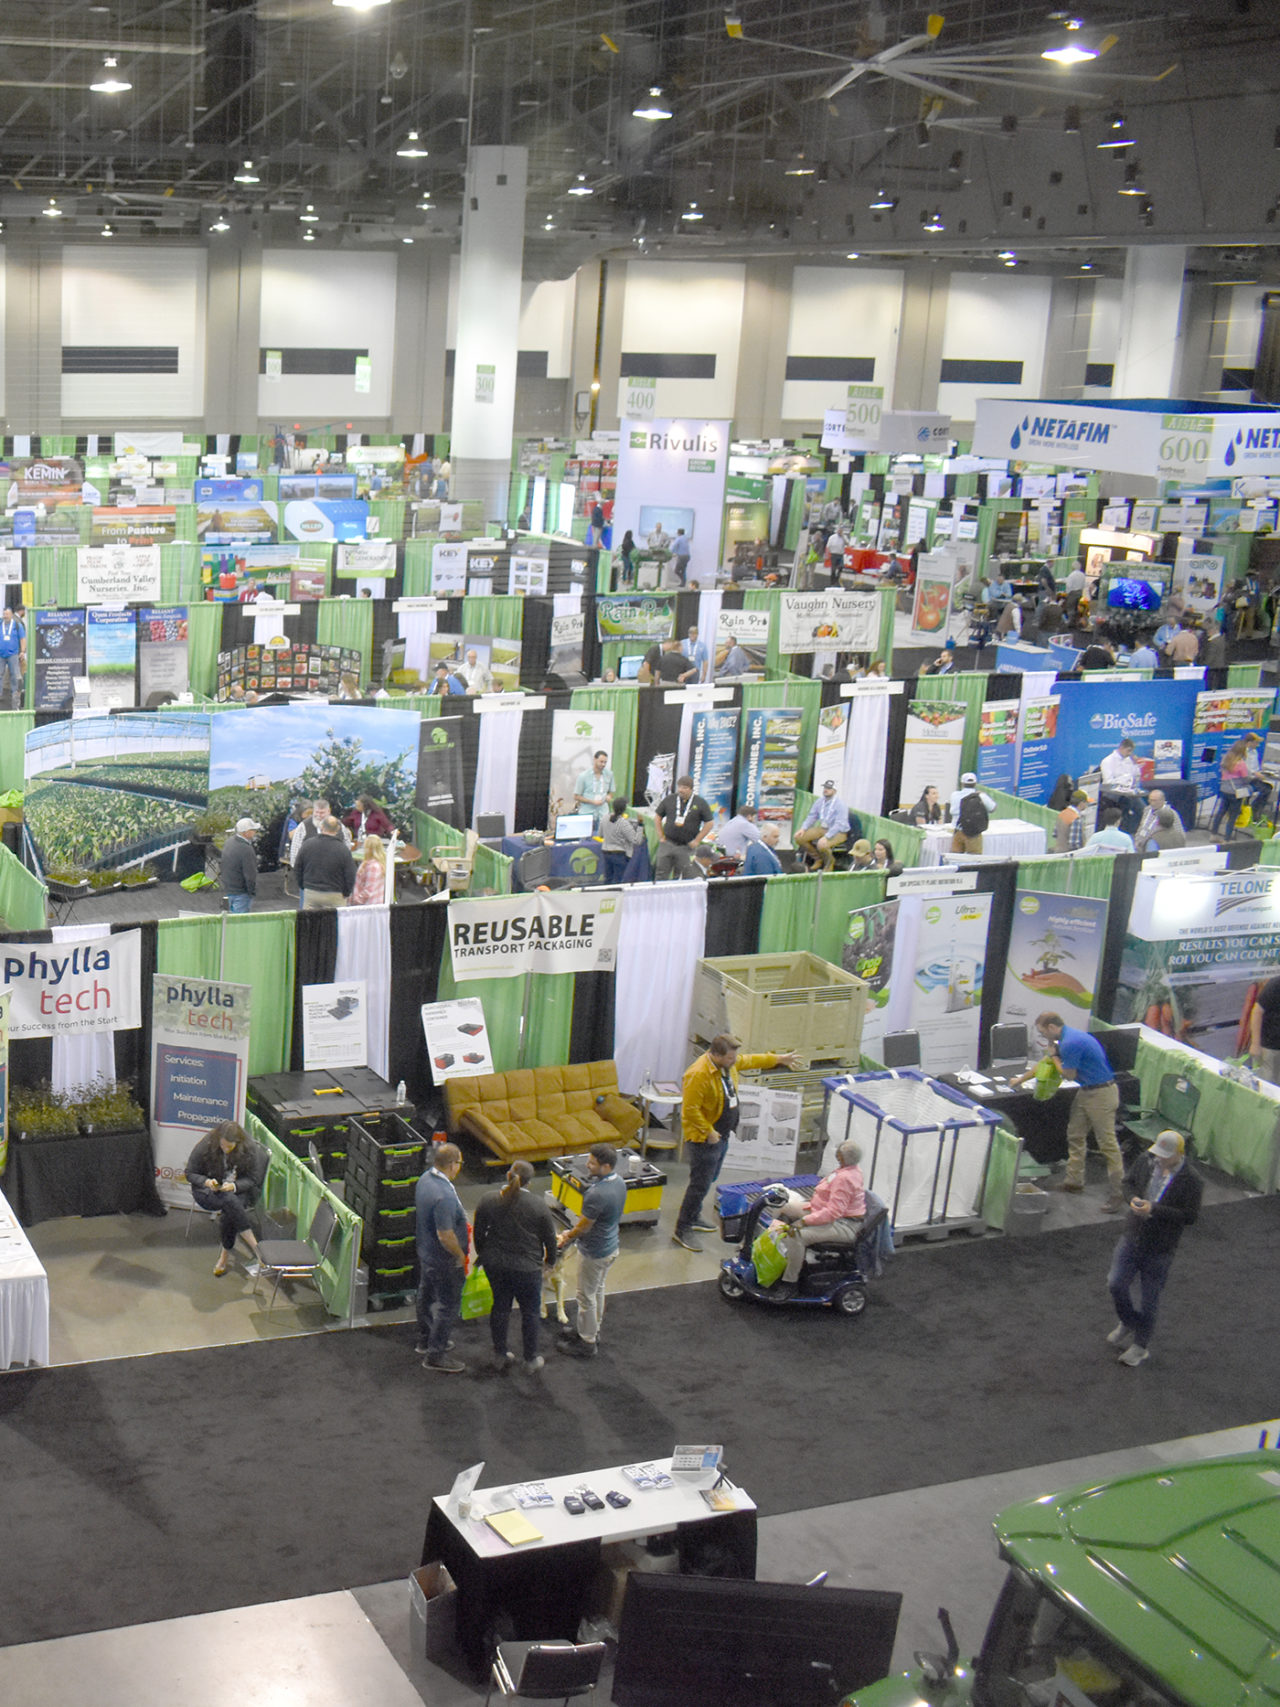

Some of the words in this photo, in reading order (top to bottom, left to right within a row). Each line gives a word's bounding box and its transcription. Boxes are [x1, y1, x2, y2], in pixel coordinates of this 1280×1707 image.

[476, 377, 494, 392] 300
[627, 391, 654, 409] 400
[846, 403, 880, 424] 500
[1168, 417, 1206, 430] AISLE
[650, 433, 718, 453] Rivulis
[1245, 428, 1280, 449] NET
[1160, 436, 1209, 464] 600
[24, 466, 66, 480] KEMIN
[102, 527, 127, 536] From
[127, 526, 166, 535] Pasture
[439, 550, 459, 558] KEY
[470, 557, 495, 569] KEY
[81, 576, 131, 584] Cumberland
[133, 575, 156, 584] Valley
[133, 584, 149, 592] Inc.
[600, 600, 637, 624] Rain
[786, 598, 828, 612] Vaughn
[832, 597, 877, 610] Nursery
[720, 614, 745, 627] Rain
[696, 718, 706, 741] INC.
[751, 715, 763, 739] INC.
[1102, 712, 1157, 730] BioSafe
[1120, 728, 1156, 737] Systems
[693, 742, 705, 795] MPANIES,
[1220, 879, 1273, 896] TELONE
[454, 914, 595, 946] REUSABLE
[454, 943, 525, 958] TRANSPORT
[528, 938, 593, 951] PACKAGING
[1178, 940, 1223, 952] RESULTS
[1225, 938, 1248, 948] YOU
[1249, 936, 1273, 947] CAN
[1168, 955, 1188, 965] ROI
[1190, 952, 1213, 963] YOU
[1214, 951, 1239, 961] CAN
[1240, 948, 1278, 960] COUNT
[4, 946, 110, 985] phylla
[40, 979, 111, 1015] tech
[166, 983, 234, 1008] phylla
[21, 1021, 56, 1032] Success
[58, 1021, 78, 1029] from
[80, 1018, 95, 1026] the
[97, 1016, 118, 1025] Start
[188, 1010, 233, 1031] tech
[164, 1054, 204, 1067] Services:
[170, 1074, 207, 1086] Initiation
[173, 1092, 229, 1107] Maintenance
